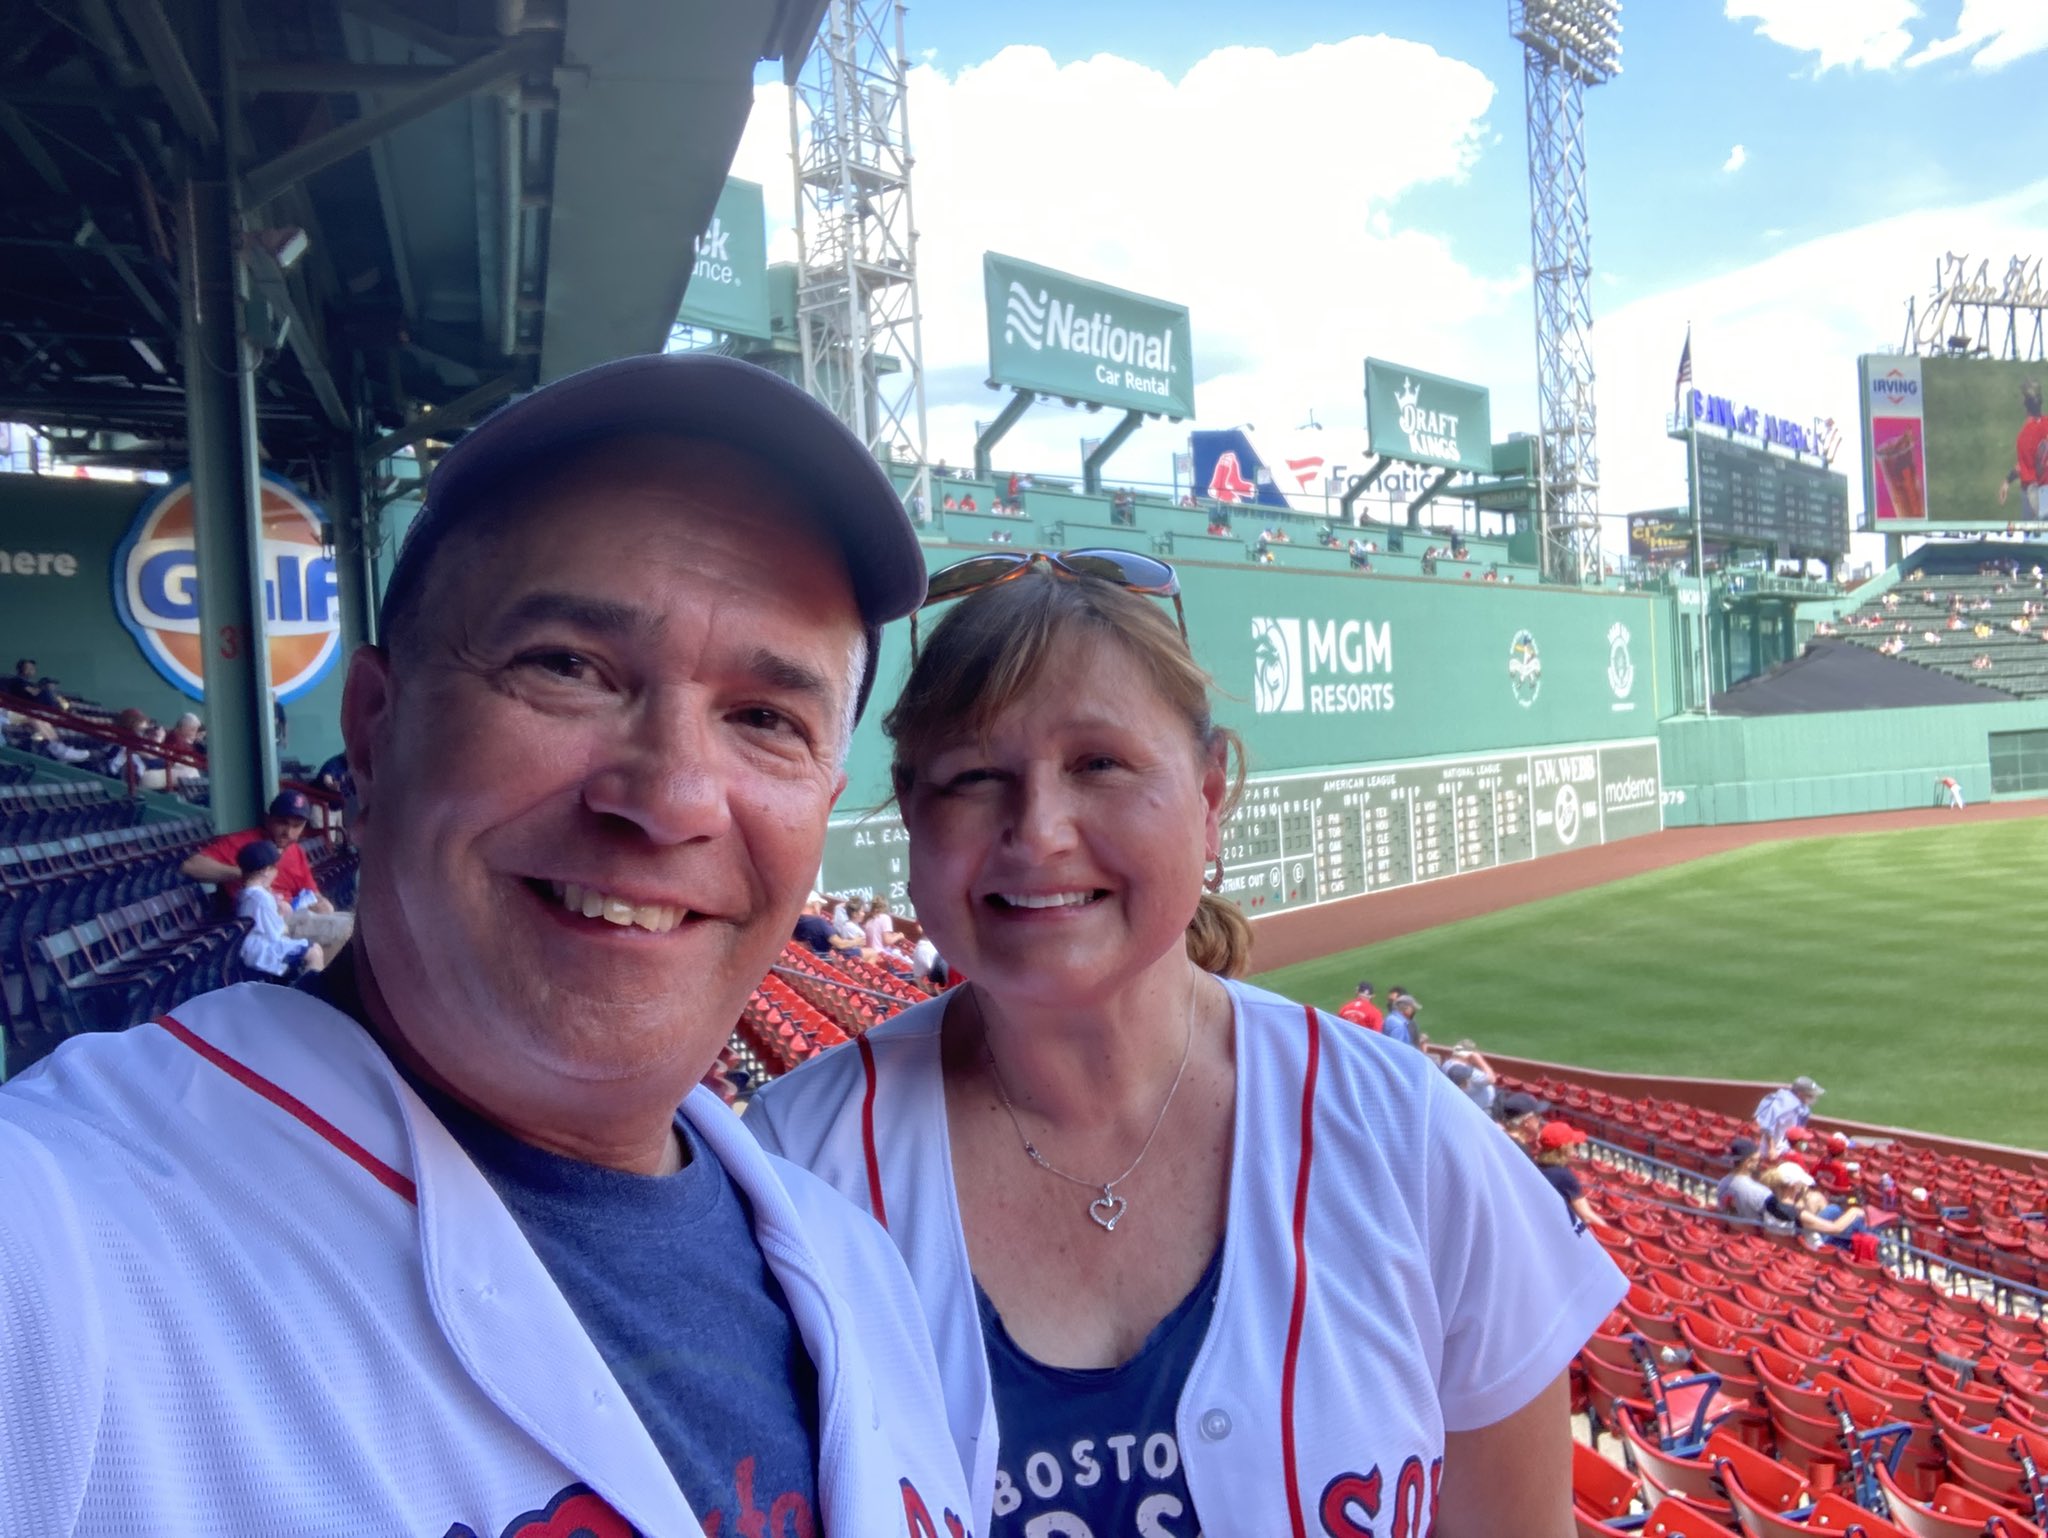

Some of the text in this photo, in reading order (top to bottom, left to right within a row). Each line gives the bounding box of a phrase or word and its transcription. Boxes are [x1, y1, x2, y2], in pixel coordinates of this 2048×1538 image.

[1046, 298, 1173, 374] National
[1095, 364, 1170, 397] Car Rental
[1872, 380, 1918, 396] IRVING
[1399, 404, 1459, 439] DRAFT
[1408, 430, 1462, 463] KINGS
[1332, 465, 1437, 493] Fanatic
[139, 548, 338, 622] Glf
[1307, 618, 1393, 674] MGM
[1309, 683, 1396, 714] RESORTS
[1323, 774, 1396, 792] AMERICAN LEAGUE
[1443, 763, 1501, 779] NATIONAL LEAGUE
[1558, 755, 1596, 783] WEBB
[1605, 774, 1655, 804] moderna
[855, 828, 911, 848] AL EAS
[890, 881, 906, 898] 25
[1248, 872, 1265, 888] OUT
[993, 1432, 1179, 1517] BOSTO
